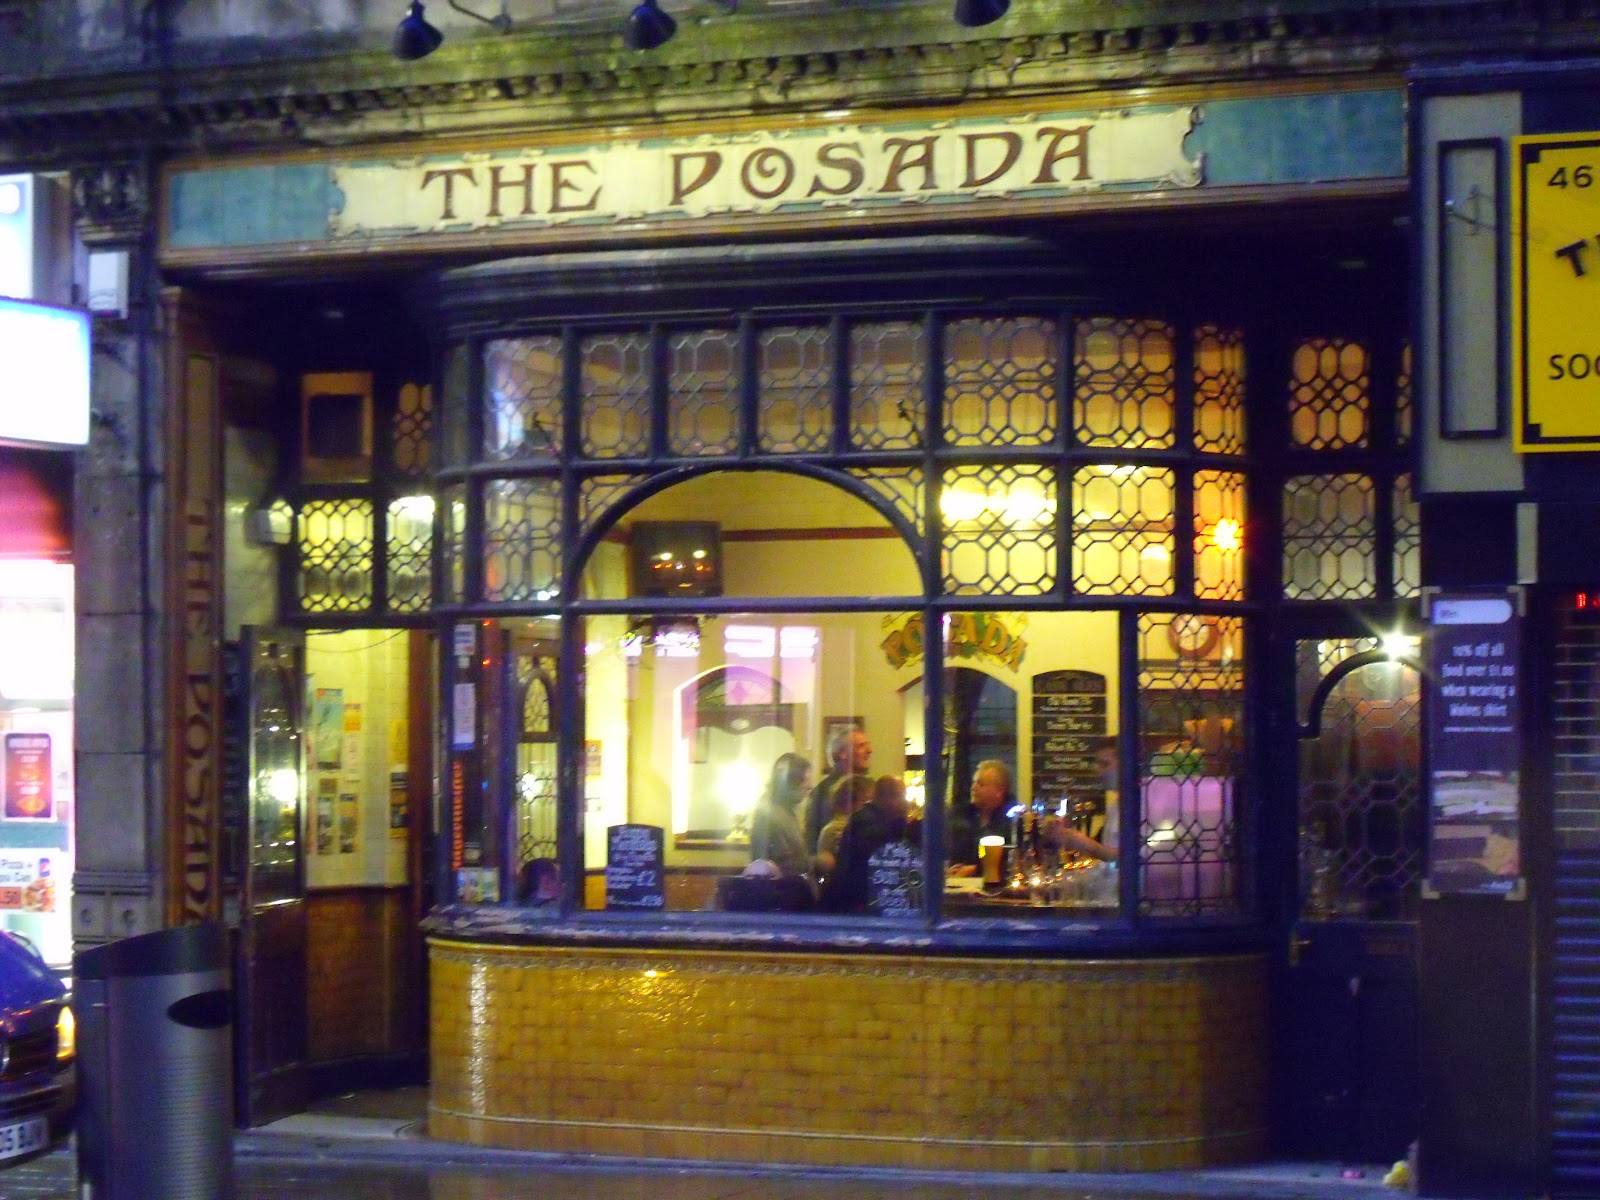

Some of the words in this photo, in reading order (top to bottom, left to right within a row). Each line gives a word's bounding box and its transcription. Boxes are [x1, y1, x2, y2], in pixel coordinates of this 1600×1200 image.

[421, 161, 604, 220] THE
[667, 124, 1096, 206] POSADA
[1547, 165, 1594, 190] 46
[185, 499, 213, 638] THE
